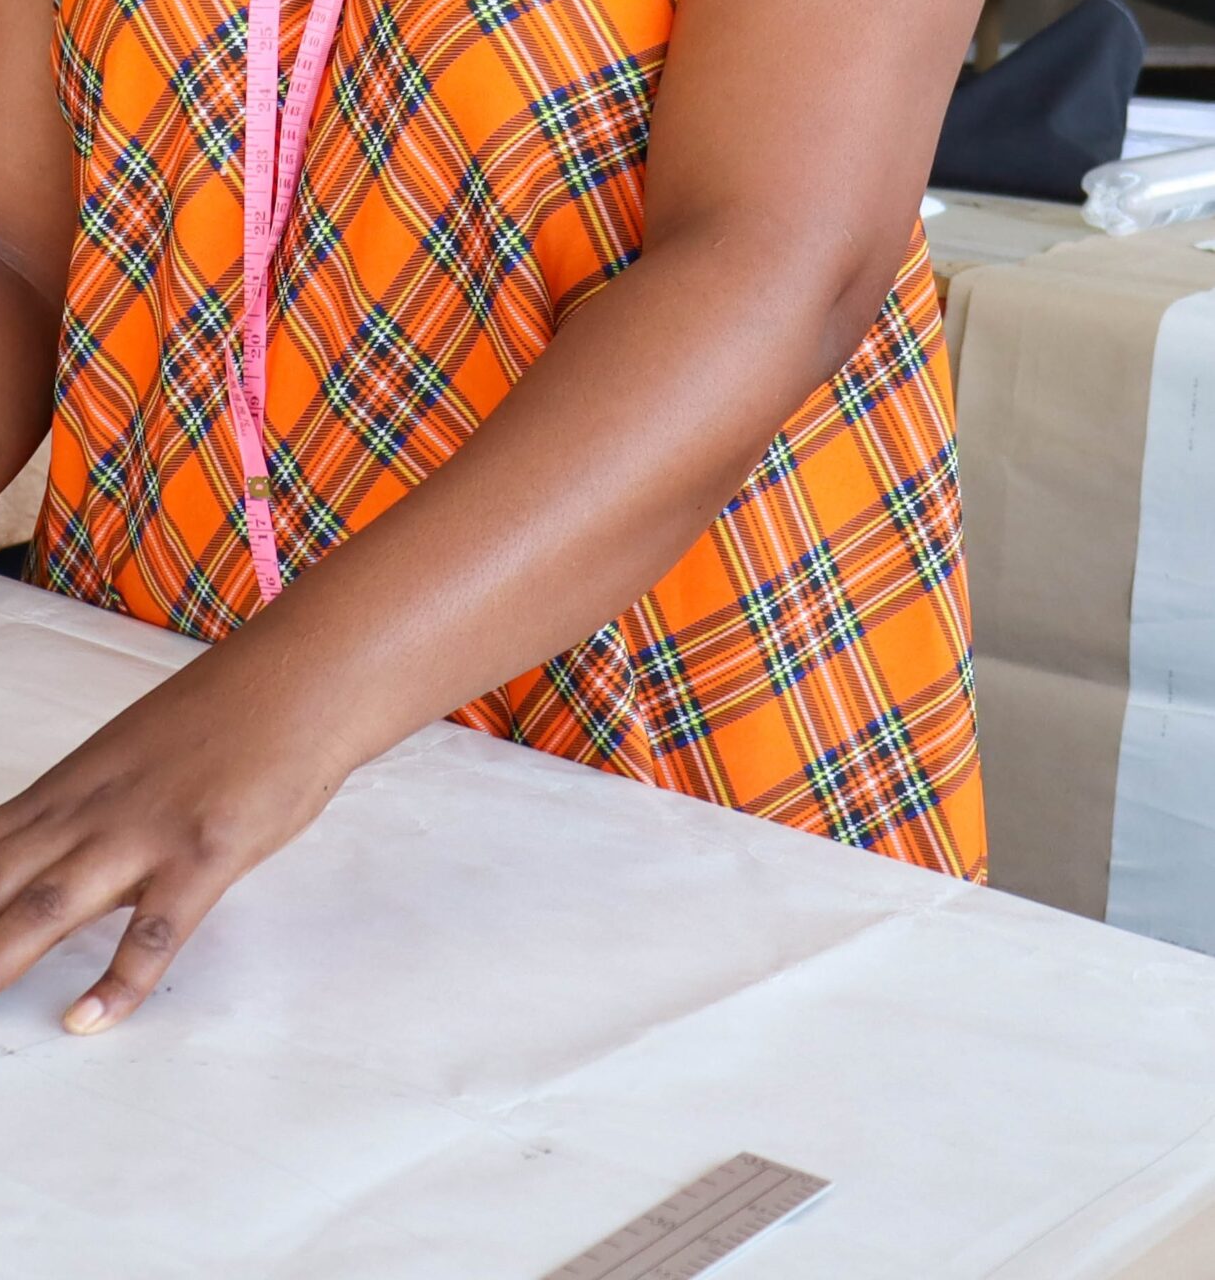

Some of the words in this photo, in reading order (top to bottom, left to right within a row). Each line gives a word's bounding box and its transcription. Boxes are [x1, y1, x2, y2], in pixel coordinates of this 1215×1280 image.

[259, 27, 273, 50] 25
[258, 88, 271, 112] 24
[257, 149, 268, 174] 23
[254, 211, 266, 235] 22
[251, 334, 261, 358] 20
